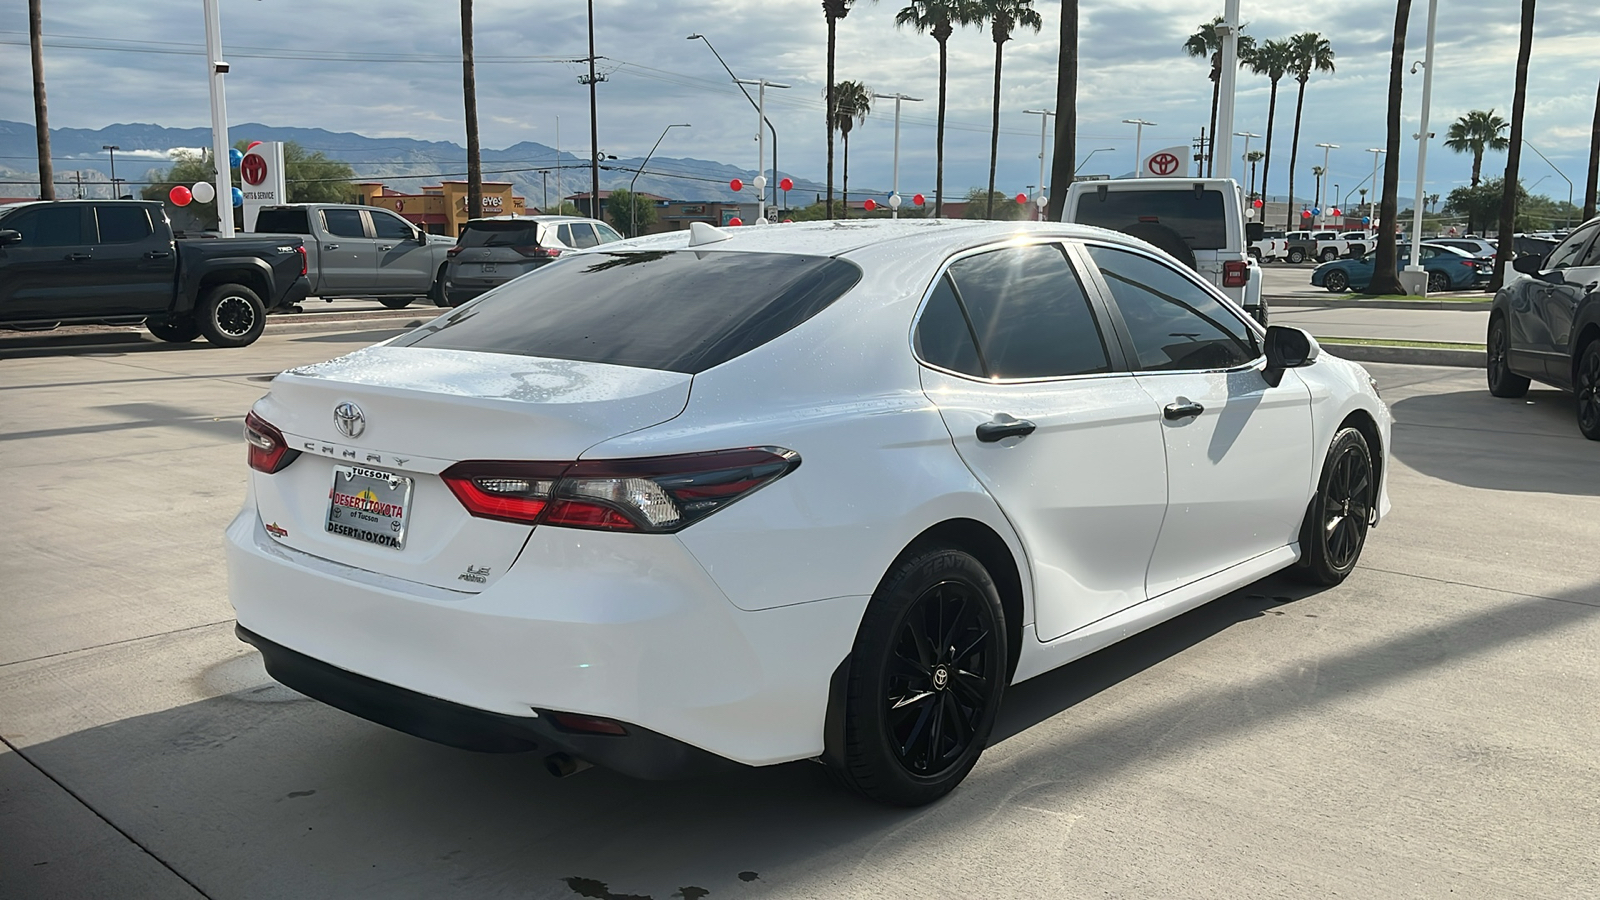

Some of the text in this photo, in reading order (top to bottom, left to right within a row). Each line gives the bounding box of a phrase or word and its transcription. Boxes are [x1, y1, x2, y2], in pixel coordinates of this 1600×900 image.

[257, 191, 274, 200] SERVICE
[303, 442, 410, 467] CAMRY
[353, 467, 390, 481] TUCSON
[334, 493, 403, 519] DESERT TOYOTA
[358, 512, 379, 523] Tucson
[328, 522, 397, 548] DESERT TOYOTA
[467, 564, 491, 576] LE
